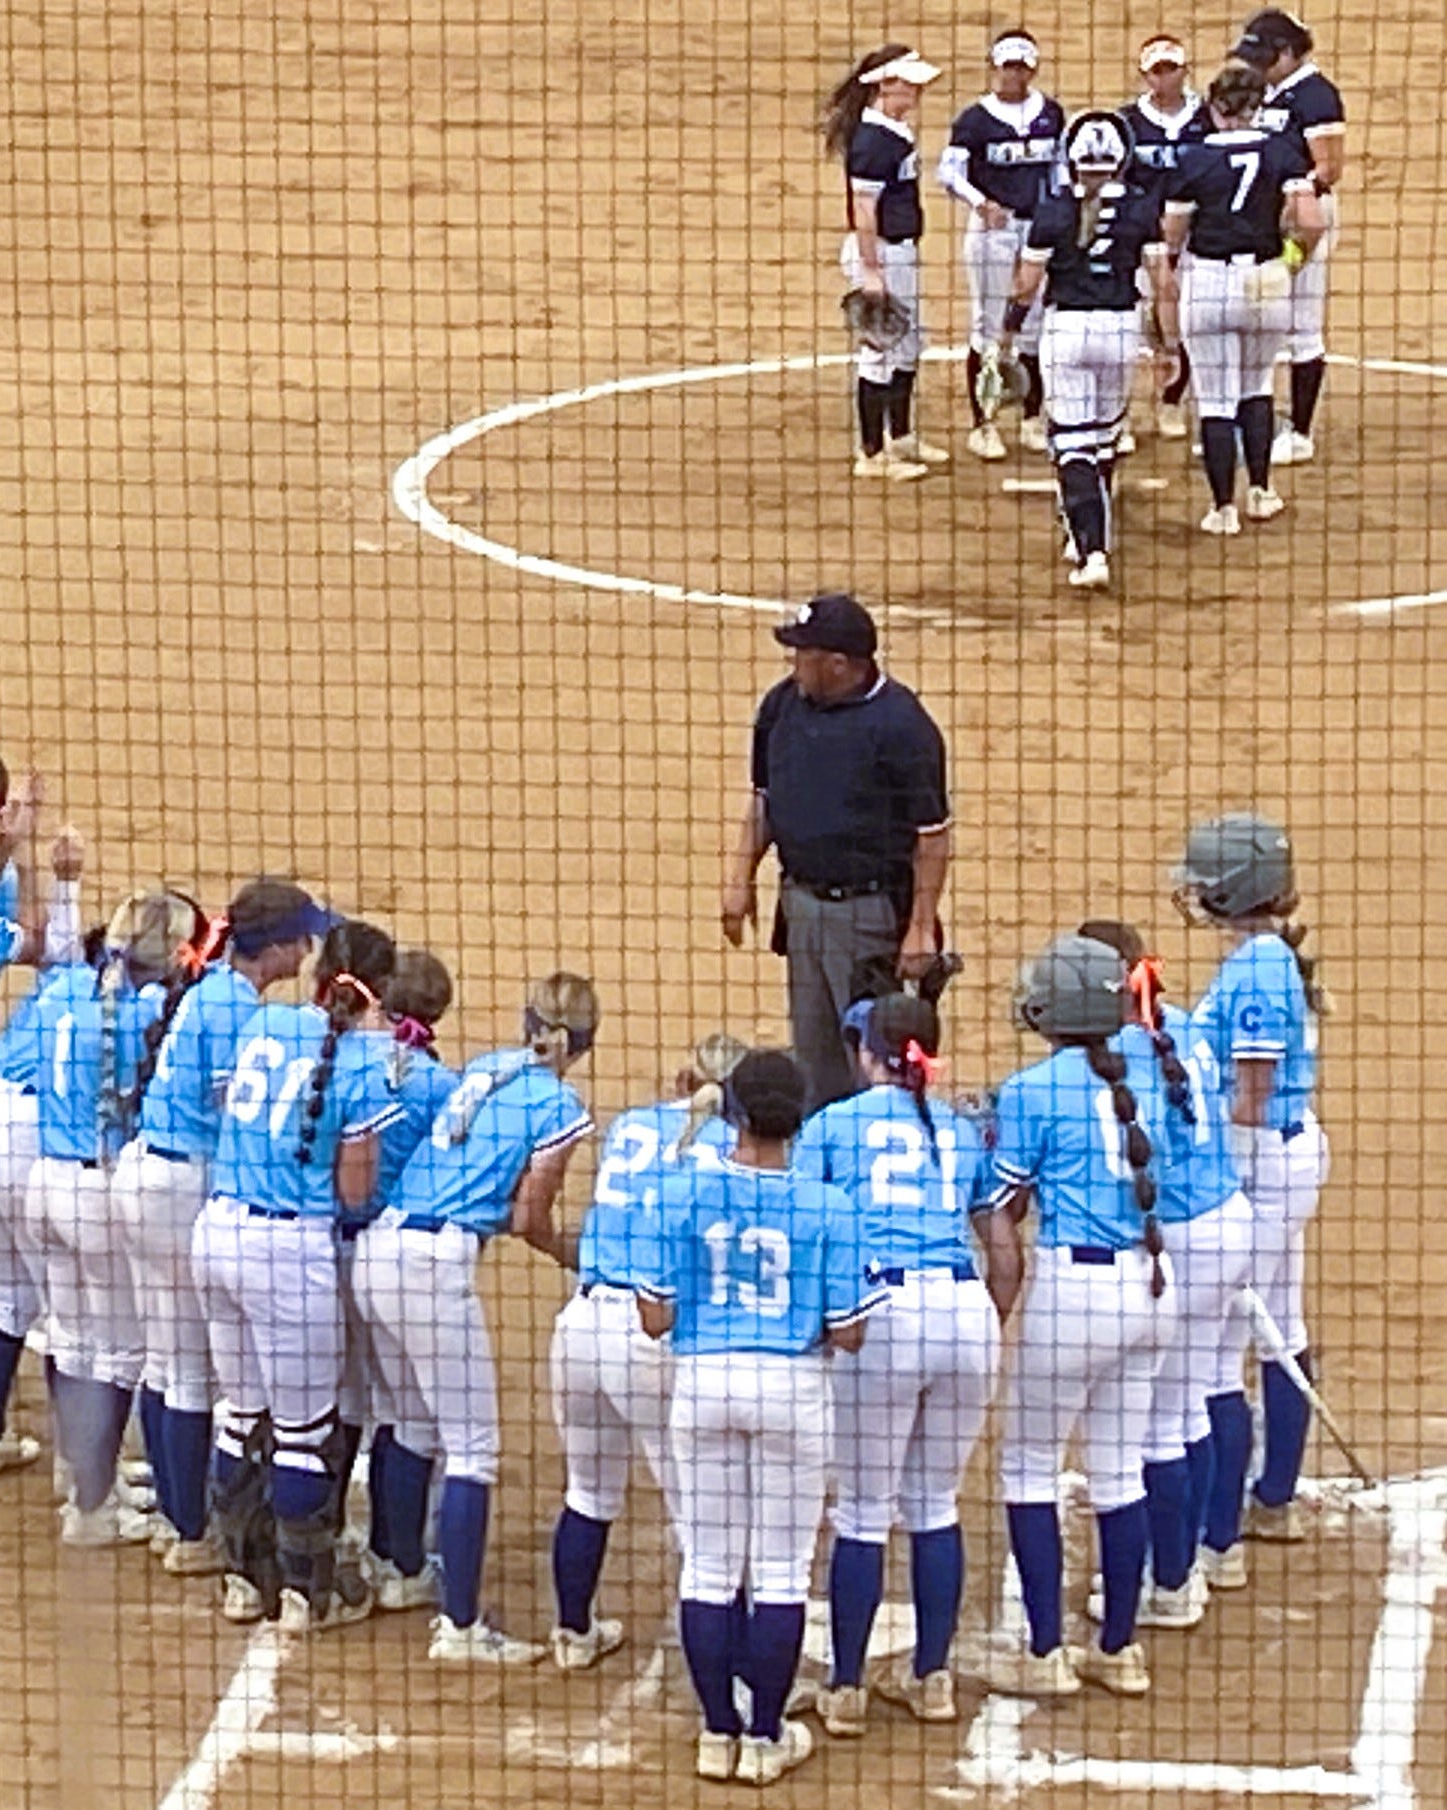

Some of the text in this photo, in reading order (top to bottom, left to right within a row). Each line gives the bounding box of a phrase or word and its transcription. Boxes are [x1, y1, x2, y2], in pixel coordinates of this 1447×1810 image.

[1229, 151, 1260, 213] 7
[1239, 1005, 1262, 1032] C
[865, 1119, 958, 1212] 21
[704, 1220, 792, 1317] 13
